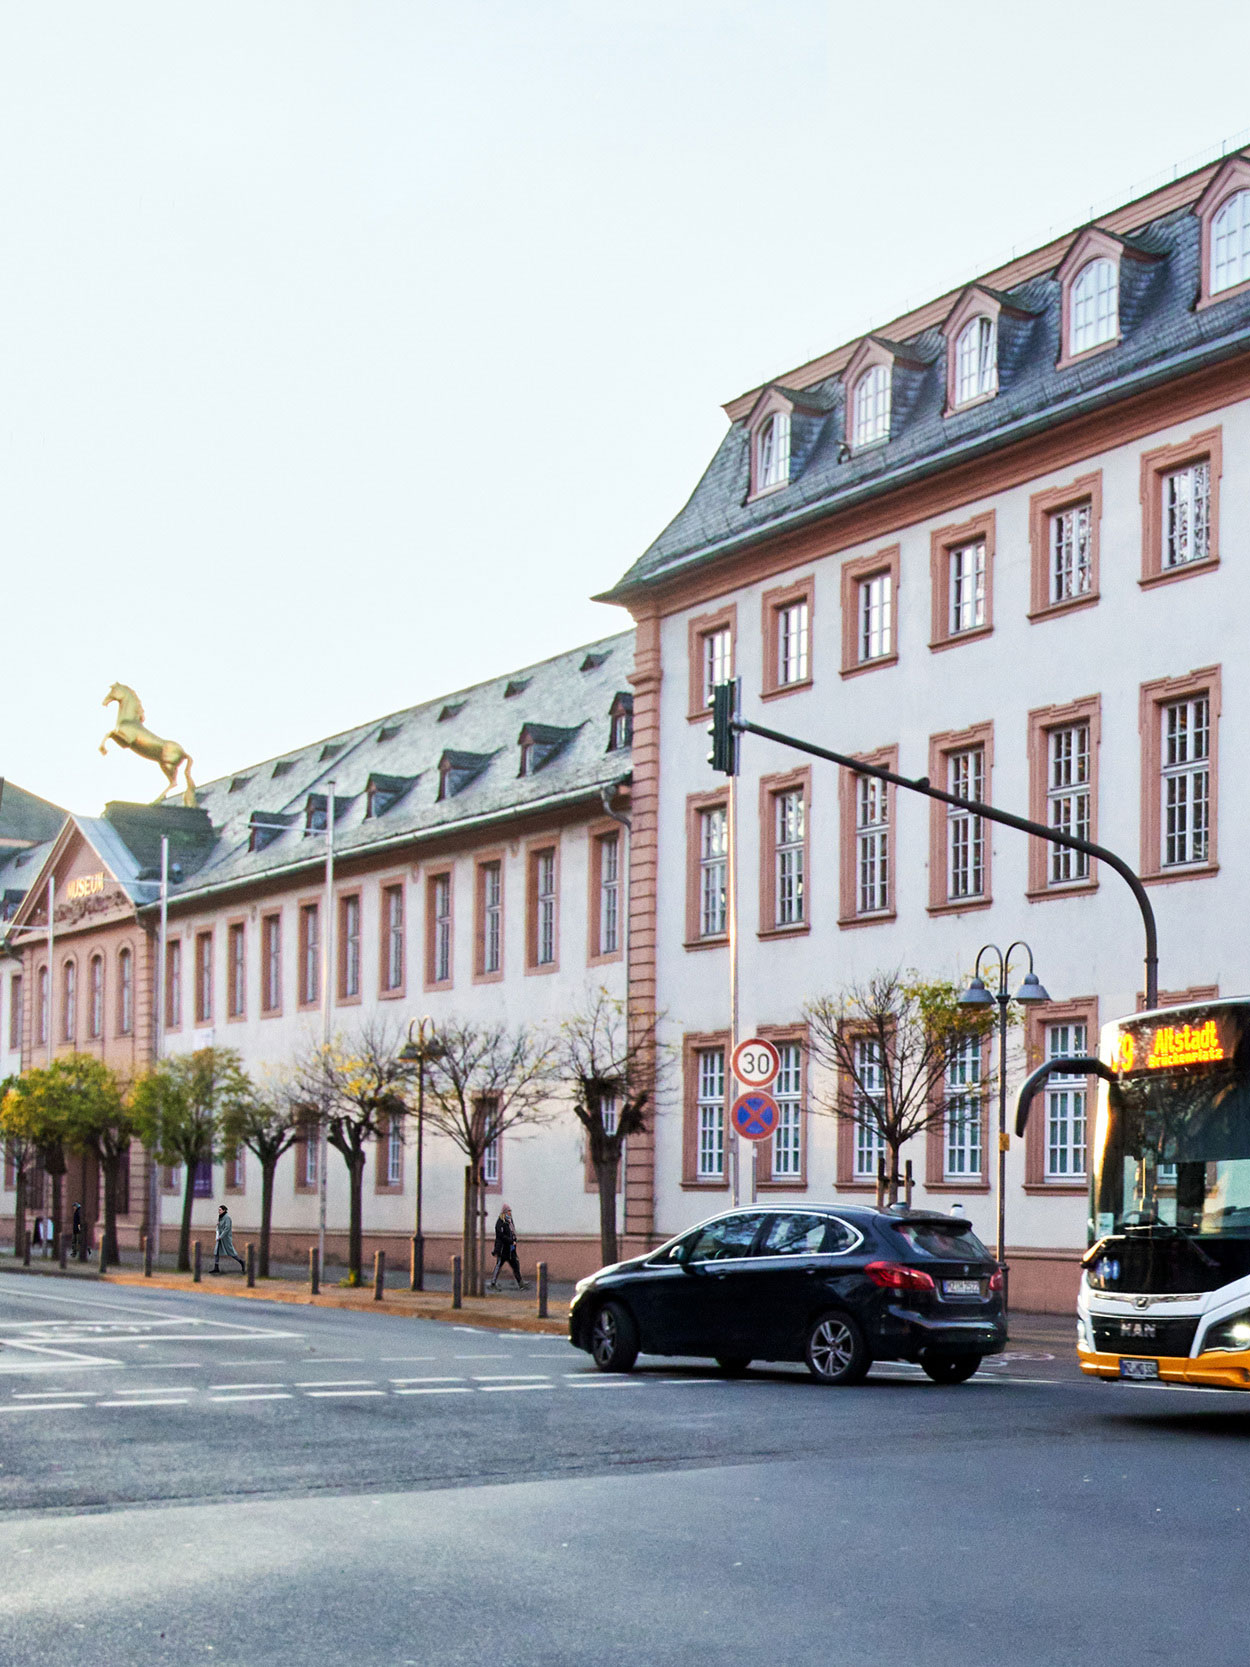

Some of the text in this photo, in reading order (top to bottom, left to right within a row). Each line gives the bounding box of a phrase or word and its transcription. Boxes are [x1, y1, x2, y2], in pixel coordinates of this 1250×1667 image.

[66, 872, 104, 900] MUSEUM
[1154, 1020, 1219, 1055] Altstadt
[743, 1052, 770, 1074] 30
[1147, 1047, 1224, 1069] Brückenplatz
[1120, 1323, 1157, 1338] MAN
